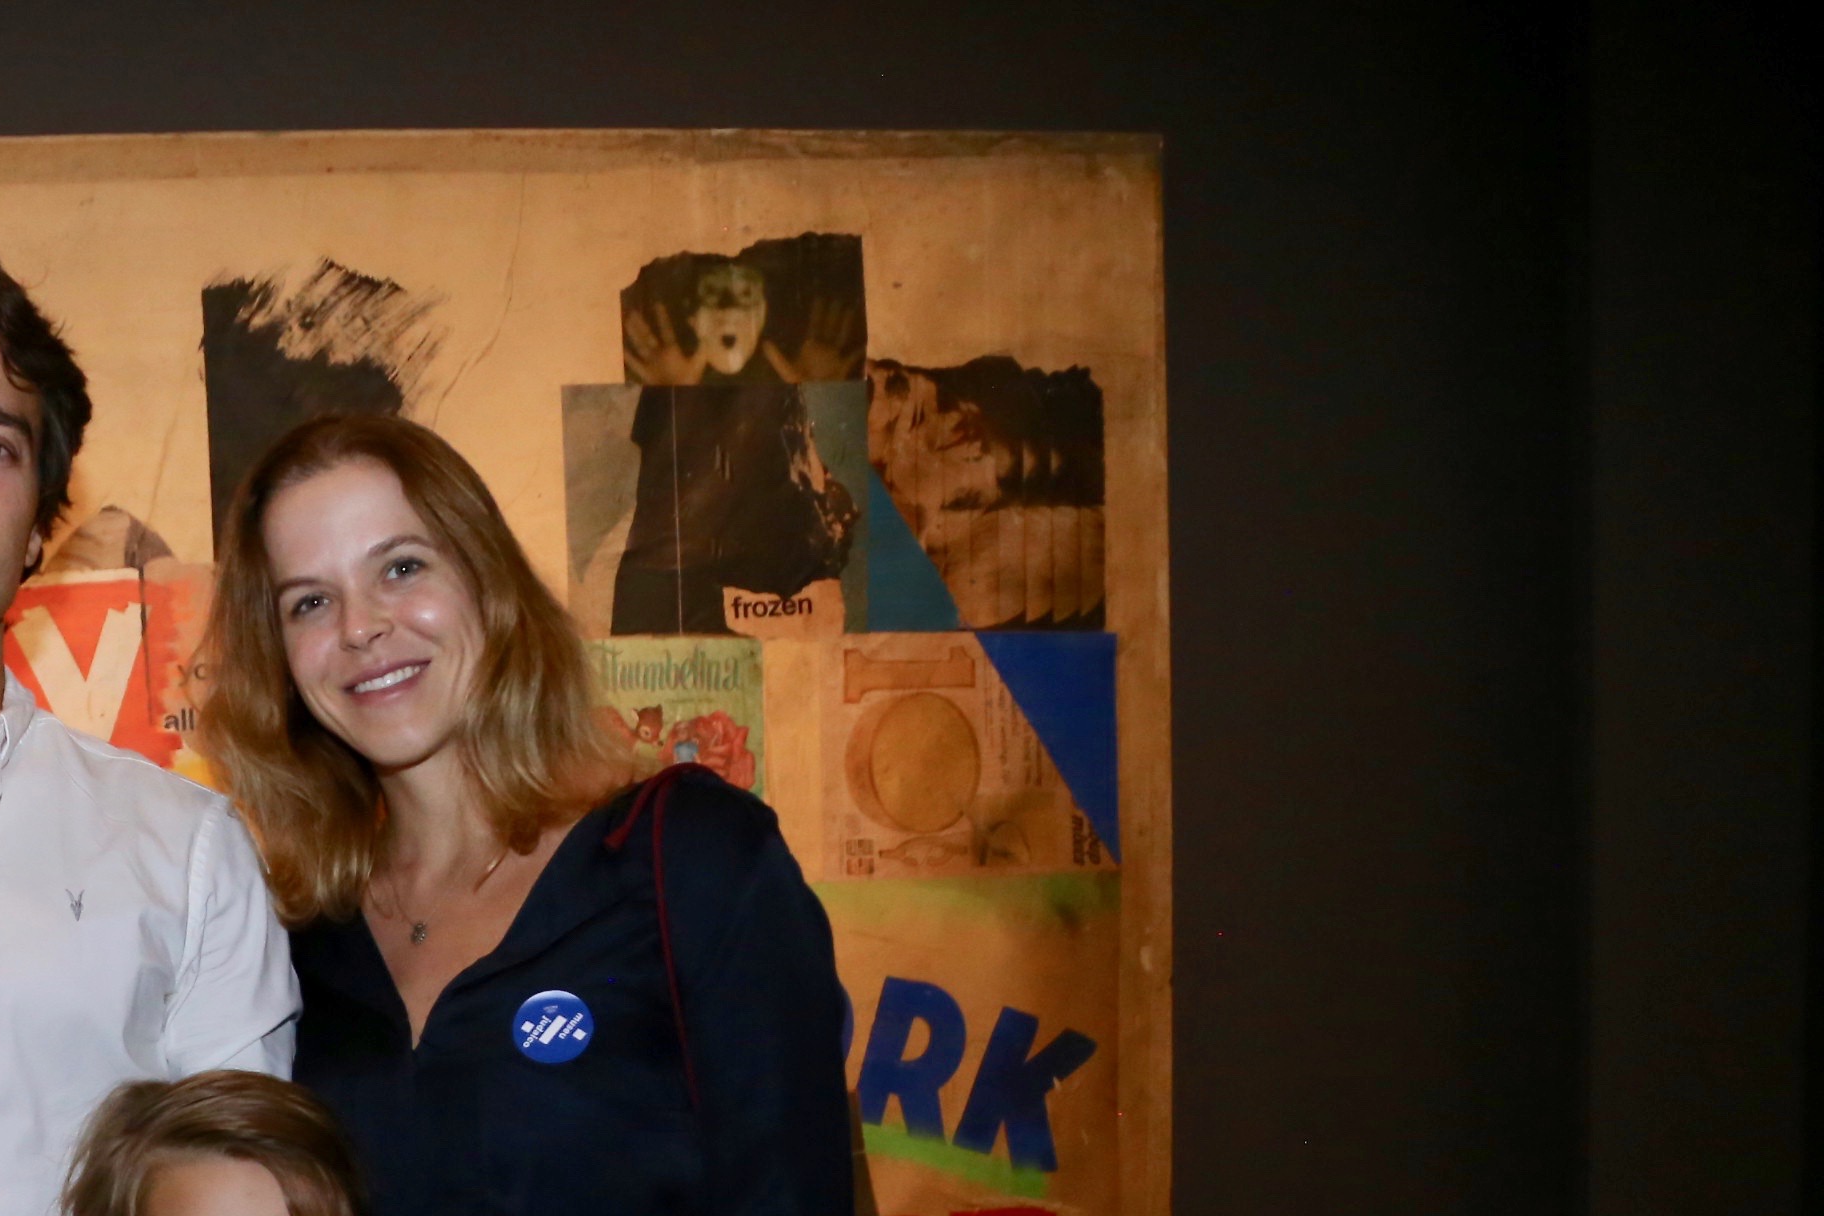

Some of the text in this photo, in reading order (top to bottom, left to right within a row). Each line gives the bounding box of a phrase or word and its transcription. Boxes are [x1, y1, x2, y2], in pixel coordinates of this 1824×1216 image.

[731, 596, 814, 620] frozen
[163, 707, 195, 732] all
[522, 1015, 552, 1048] judaico
[558, 1012, 584, 1039] museu
[842, 975, 1098, 1173] RK
